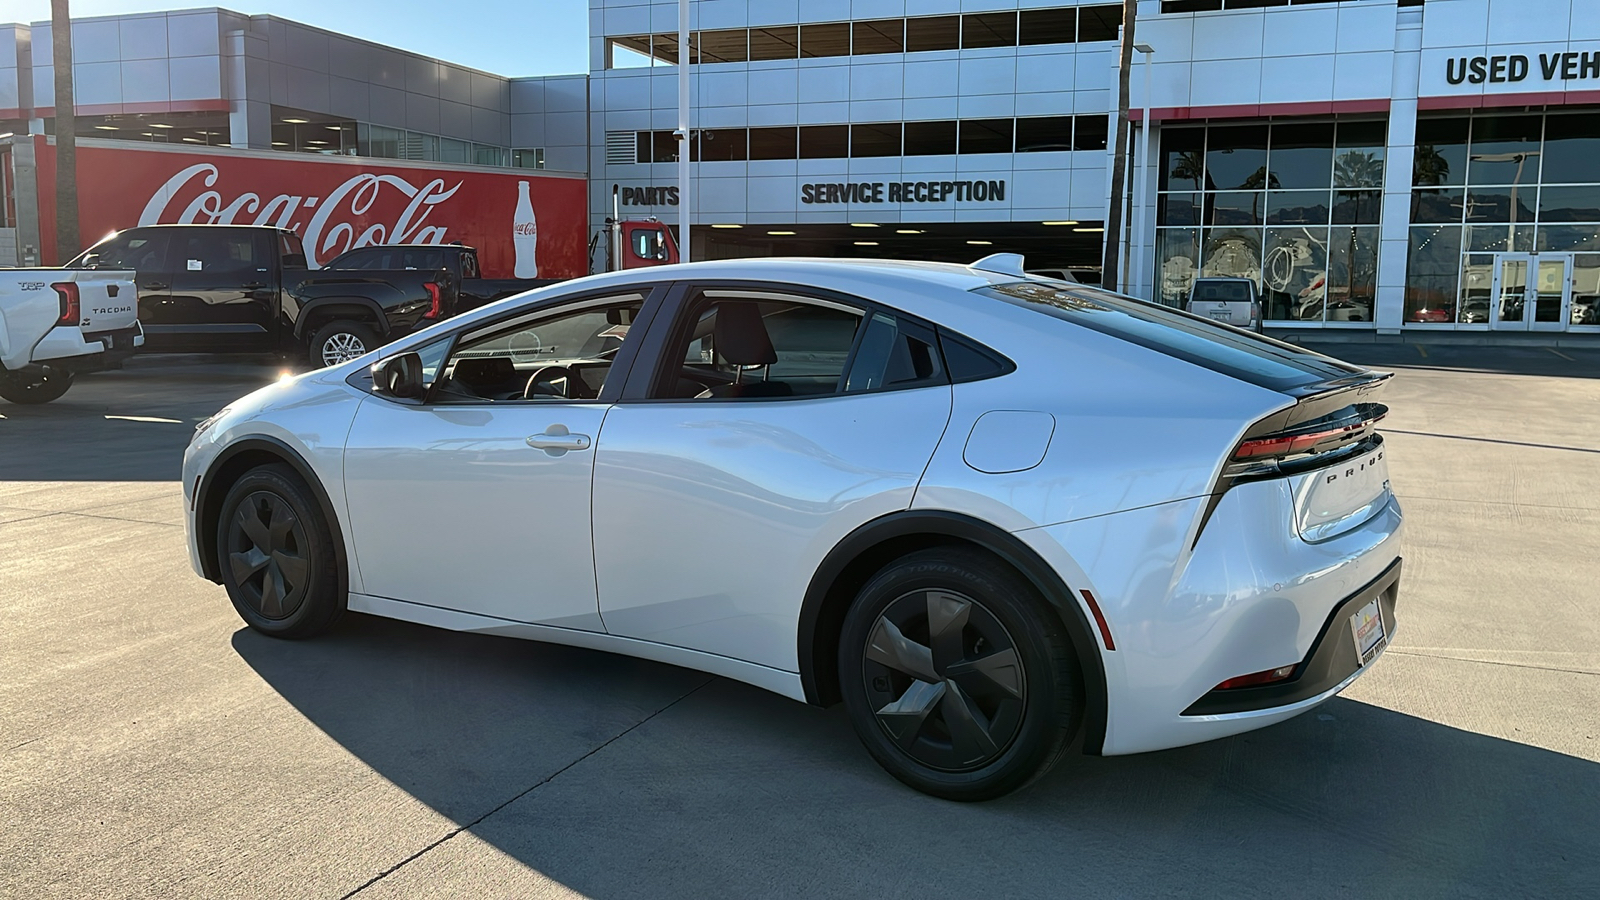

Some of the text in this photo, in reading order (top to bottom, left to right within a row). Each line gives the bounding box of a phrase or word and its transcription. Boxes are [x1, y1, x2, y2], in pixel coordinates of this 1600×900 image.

[1447, 51, 1600, 85] USED VEH
[622, 186, 679, 206] PARTS
[801, 180, 1005, 204] SERVICE RECEPTION
[92, 306, 131, 314] TACOMA
[1326, 452, 1383, 484] PRIUS
